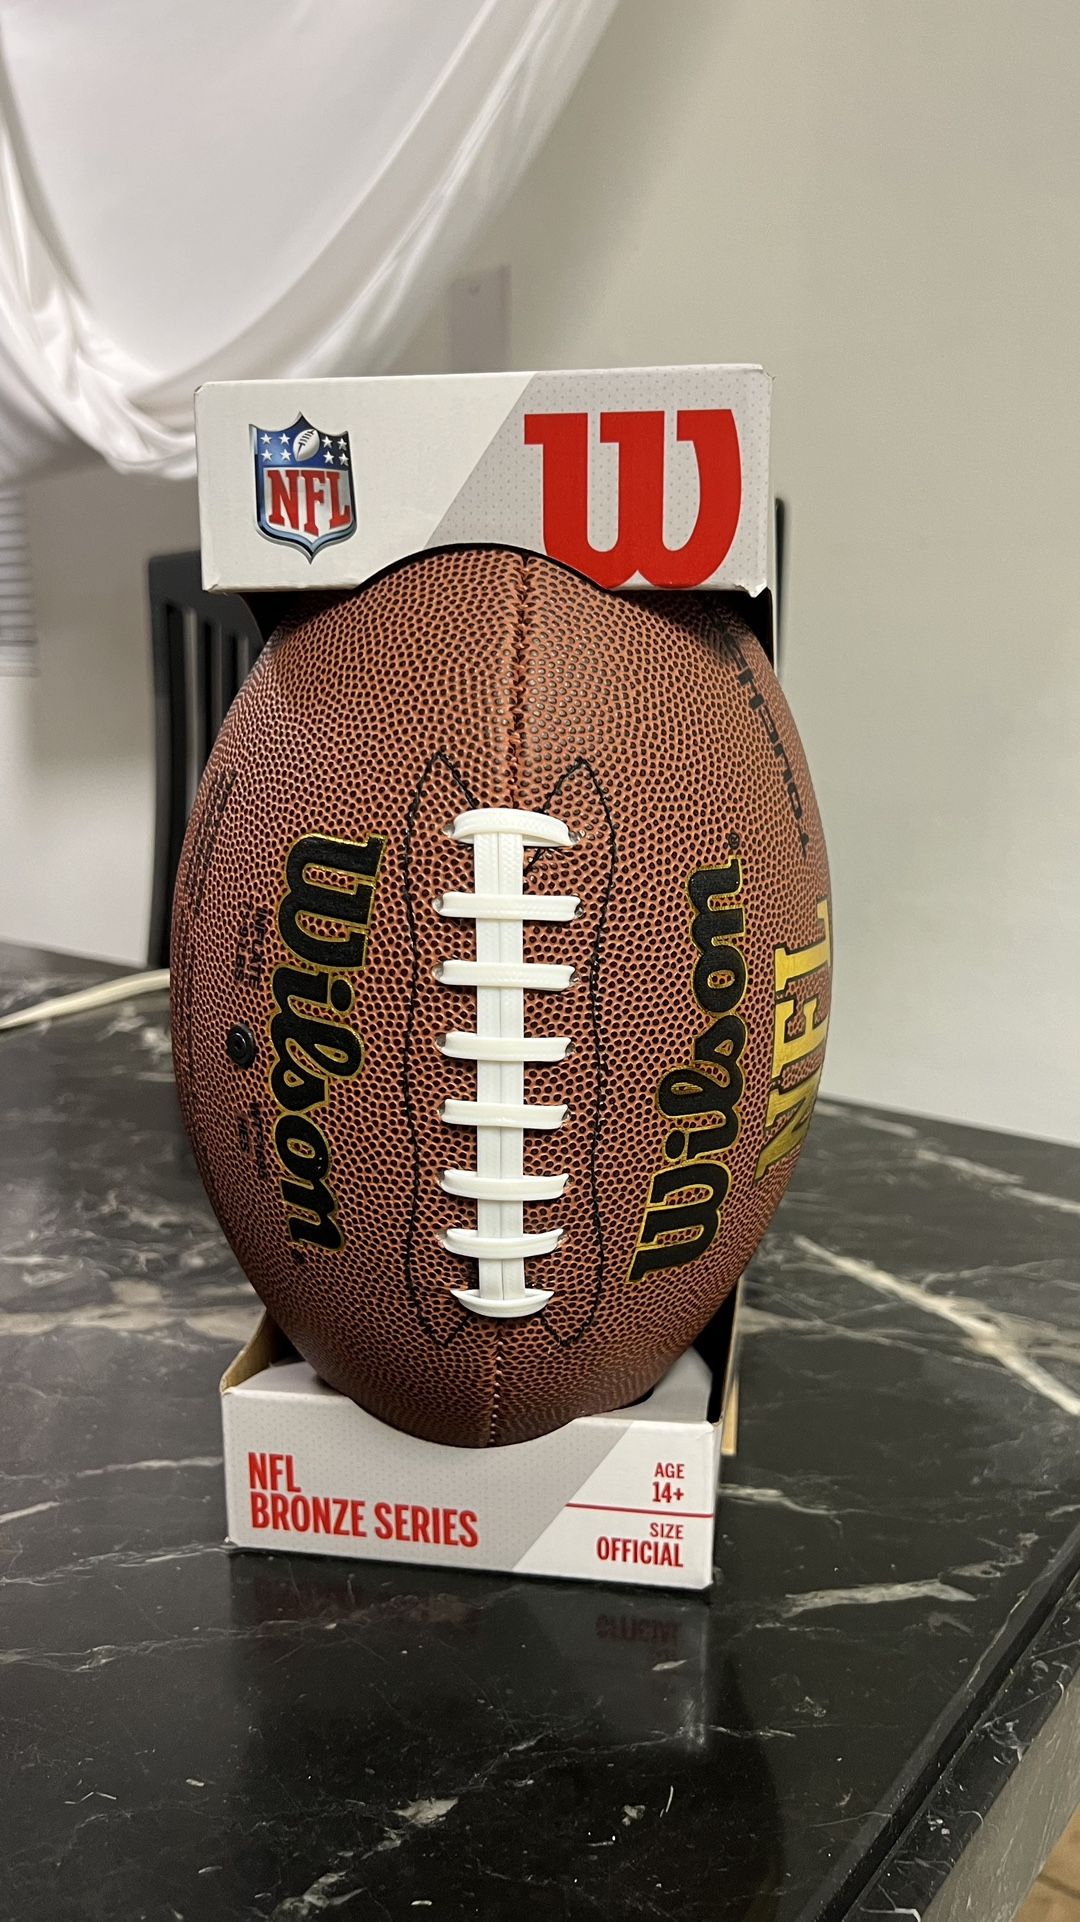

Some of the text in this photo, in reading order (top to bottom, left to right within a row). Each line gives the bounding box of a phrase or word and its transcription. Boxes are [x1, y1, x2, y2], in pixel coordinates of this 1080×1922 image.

[266, 469, 351, 537] NFL
[235, 943, 248, 983] LBS
[248, 906, 269, 990] INFLATE
[269, 834, 387, 1251] Wilson
[754, 897, 833, 1183] NFL
[625, 857, 748, 1283] Wilson
[248, 1452, 301, 1491] NFL
[652, 1481, 684, 1503] 14+
[654, 1463, 685, 1479] AGE
[251, 1492, 478, 1547] BRONZE SERIES
[650, 1522, 684, 1540] SIZE
[597, 1536, 684, 1567] OFFICIAL
